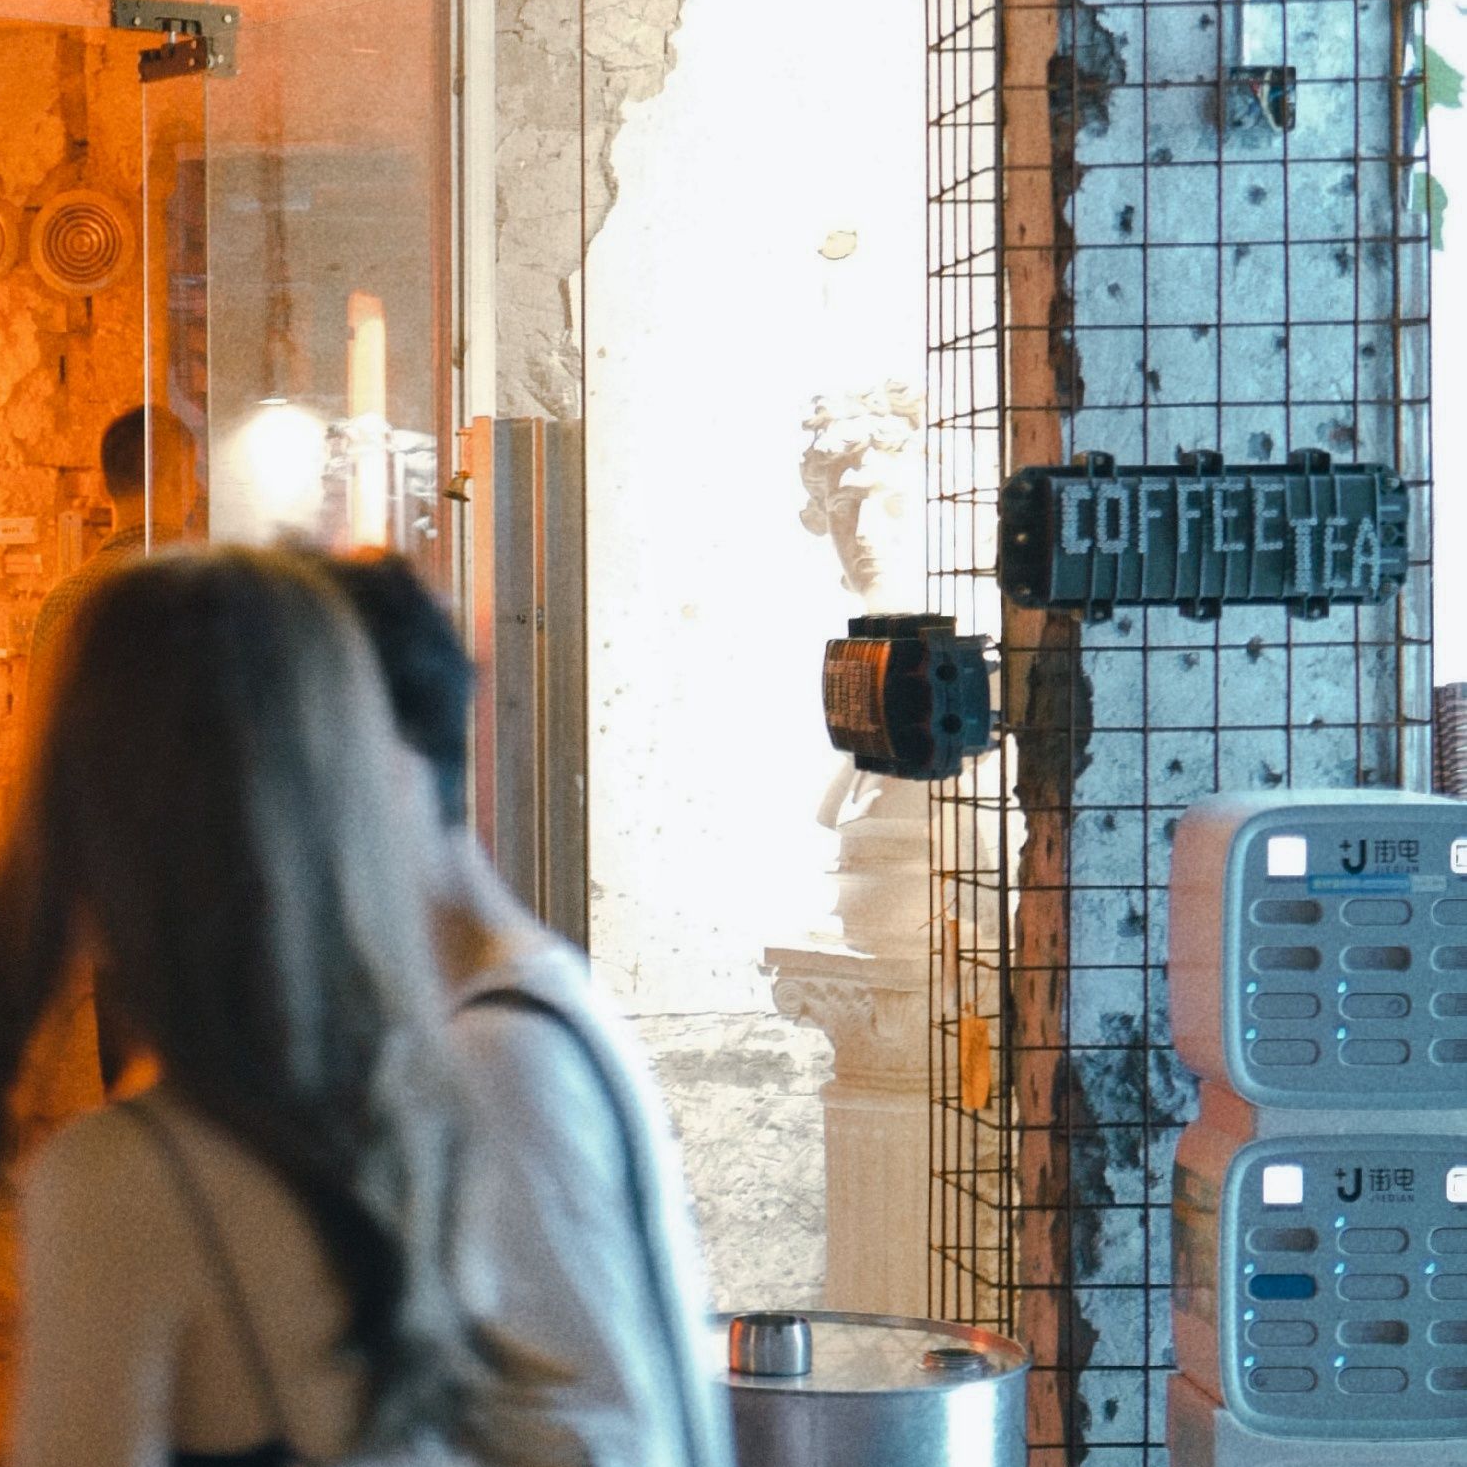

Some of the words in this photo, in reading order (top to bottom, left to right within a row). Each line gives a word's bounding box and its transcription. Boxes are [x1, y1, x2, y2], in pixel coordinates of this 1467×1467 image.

[1060, 481, 1284, 555] COFFEE
[1289, 517, 1381, 592] TEA
[1374, 839, 1420, 864] 街电
[1369, 1168, 1414, 1192] 街电
